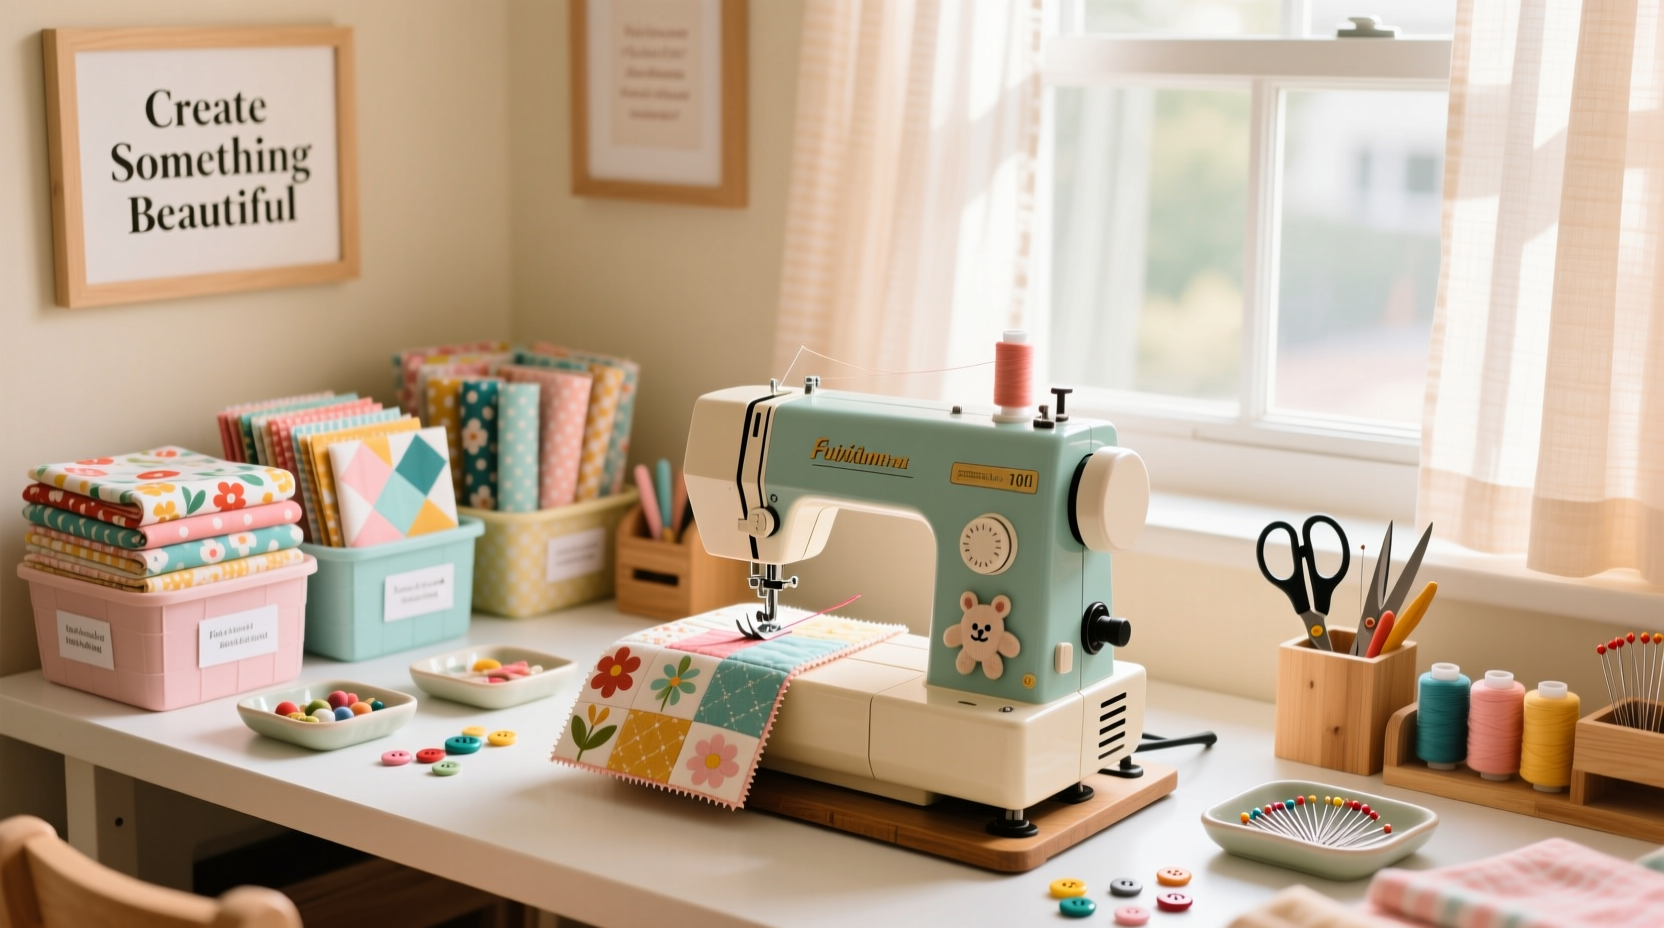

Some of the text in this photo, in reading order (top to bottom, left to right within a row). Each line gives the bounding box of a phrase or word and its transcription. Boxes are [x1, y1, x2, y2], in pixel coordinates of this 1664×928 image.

[145, 89, 267, 128] Create
[110, 135, 313, 184] Something
[128, 184, 298, 234] Beautiful
